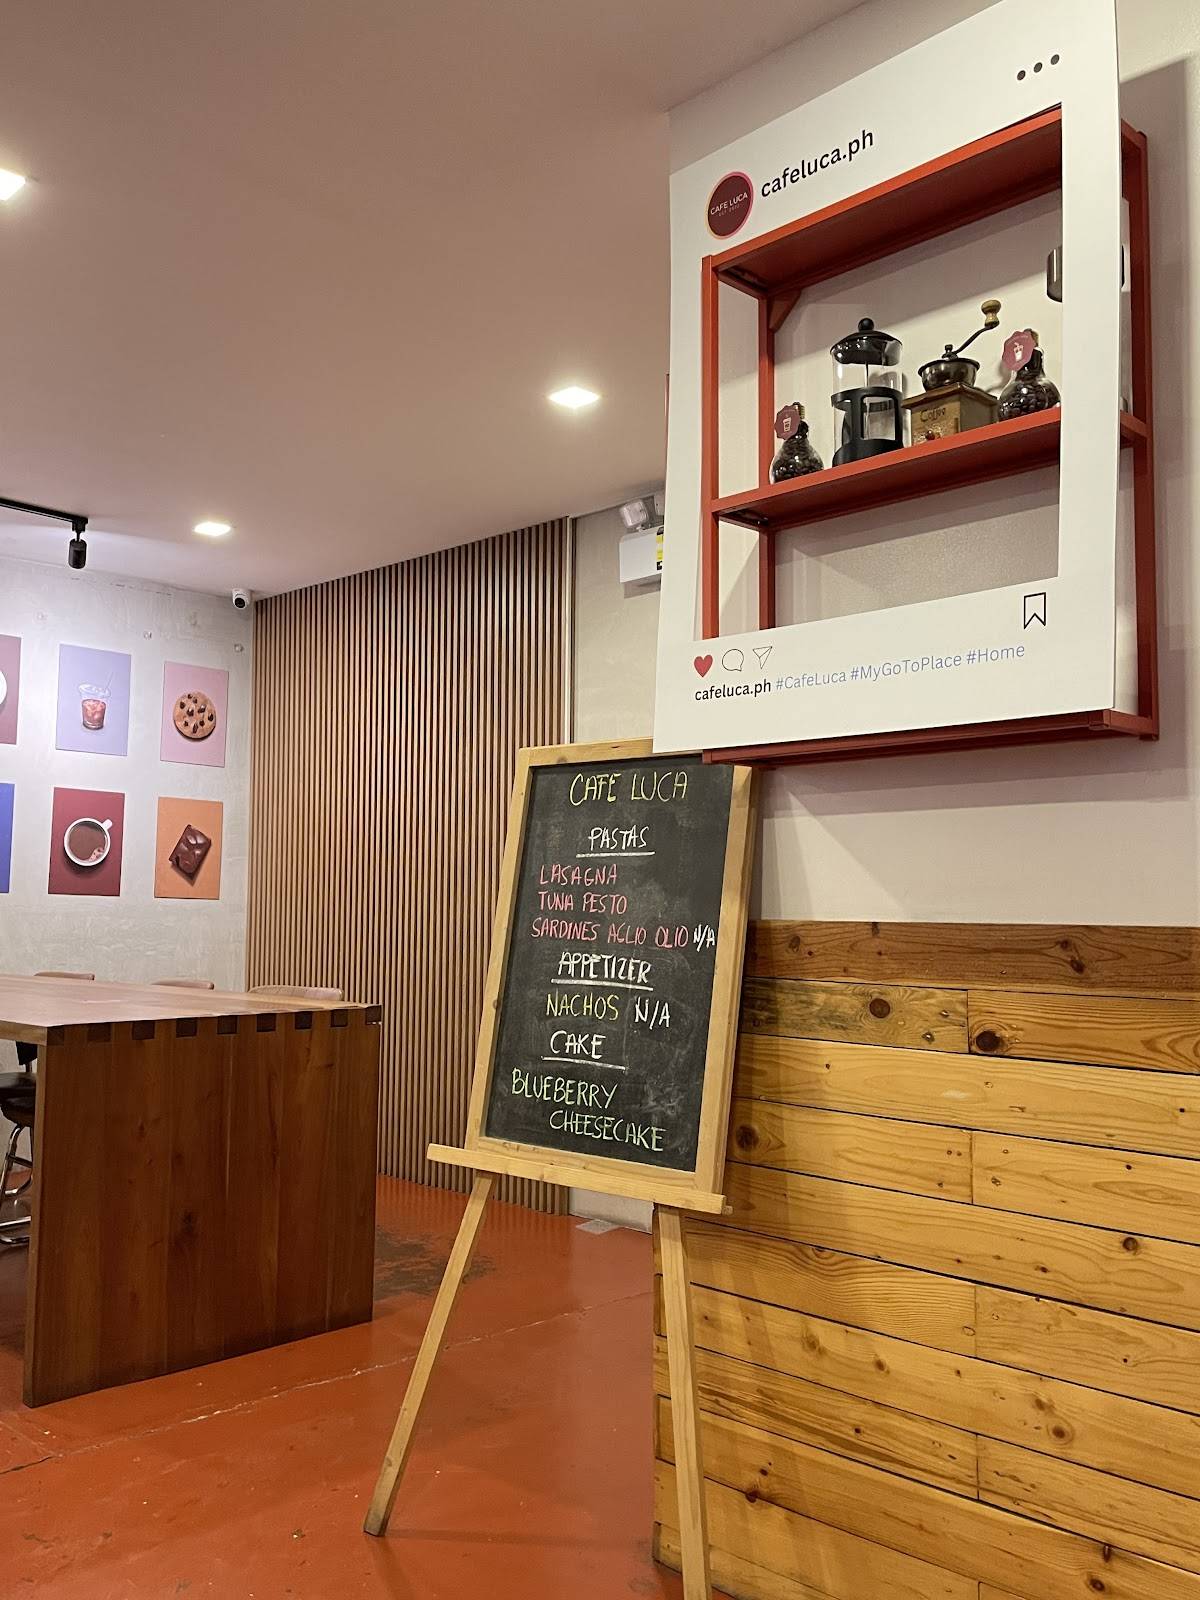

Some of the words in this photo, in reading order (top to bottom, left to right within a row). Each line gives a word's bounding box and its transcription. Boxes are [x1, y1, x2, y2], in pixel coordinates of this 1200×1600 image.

[761, 129, 874, 198] cafeluca.ph
[711, 201, 728, 215] CAFE
[729, 192, 748, 206] LUCA
[695, 678, 771, 701] cafeluca.ph
[776, 670, 847, 690] #CafeLuca
[850, 655, 962, 682] #MyGoToPlace
[966, 645, 1026, 665] #Home
[570, 772, 622, 806] CAFE
[631, 771, 688, 802] LUCA
[588, 825, 650, 850] PASTAS
[539, 864, 618, 886] LASAGNA
[538, 891, 574, 912] TUNA
[582, 892, 628, 915] PESTO
[530, 917, 601, 941] SARDINES
[607, 922, 647, 945] AGLIO
[654, 925, 689, 948] OLIO
[692, 923, 716, 952] N/A
[557, 951, 653, 984] APPETIZER
[545, 993, 620, 1021] NACHOS
[634, 996, 671, 1030] N/A
[550, 1030, 607, 1059] CAKE
[511, 1067, 619, 1109] BLUEBERRY
[549, 1110, 667, 1152] CHEESECAKE
